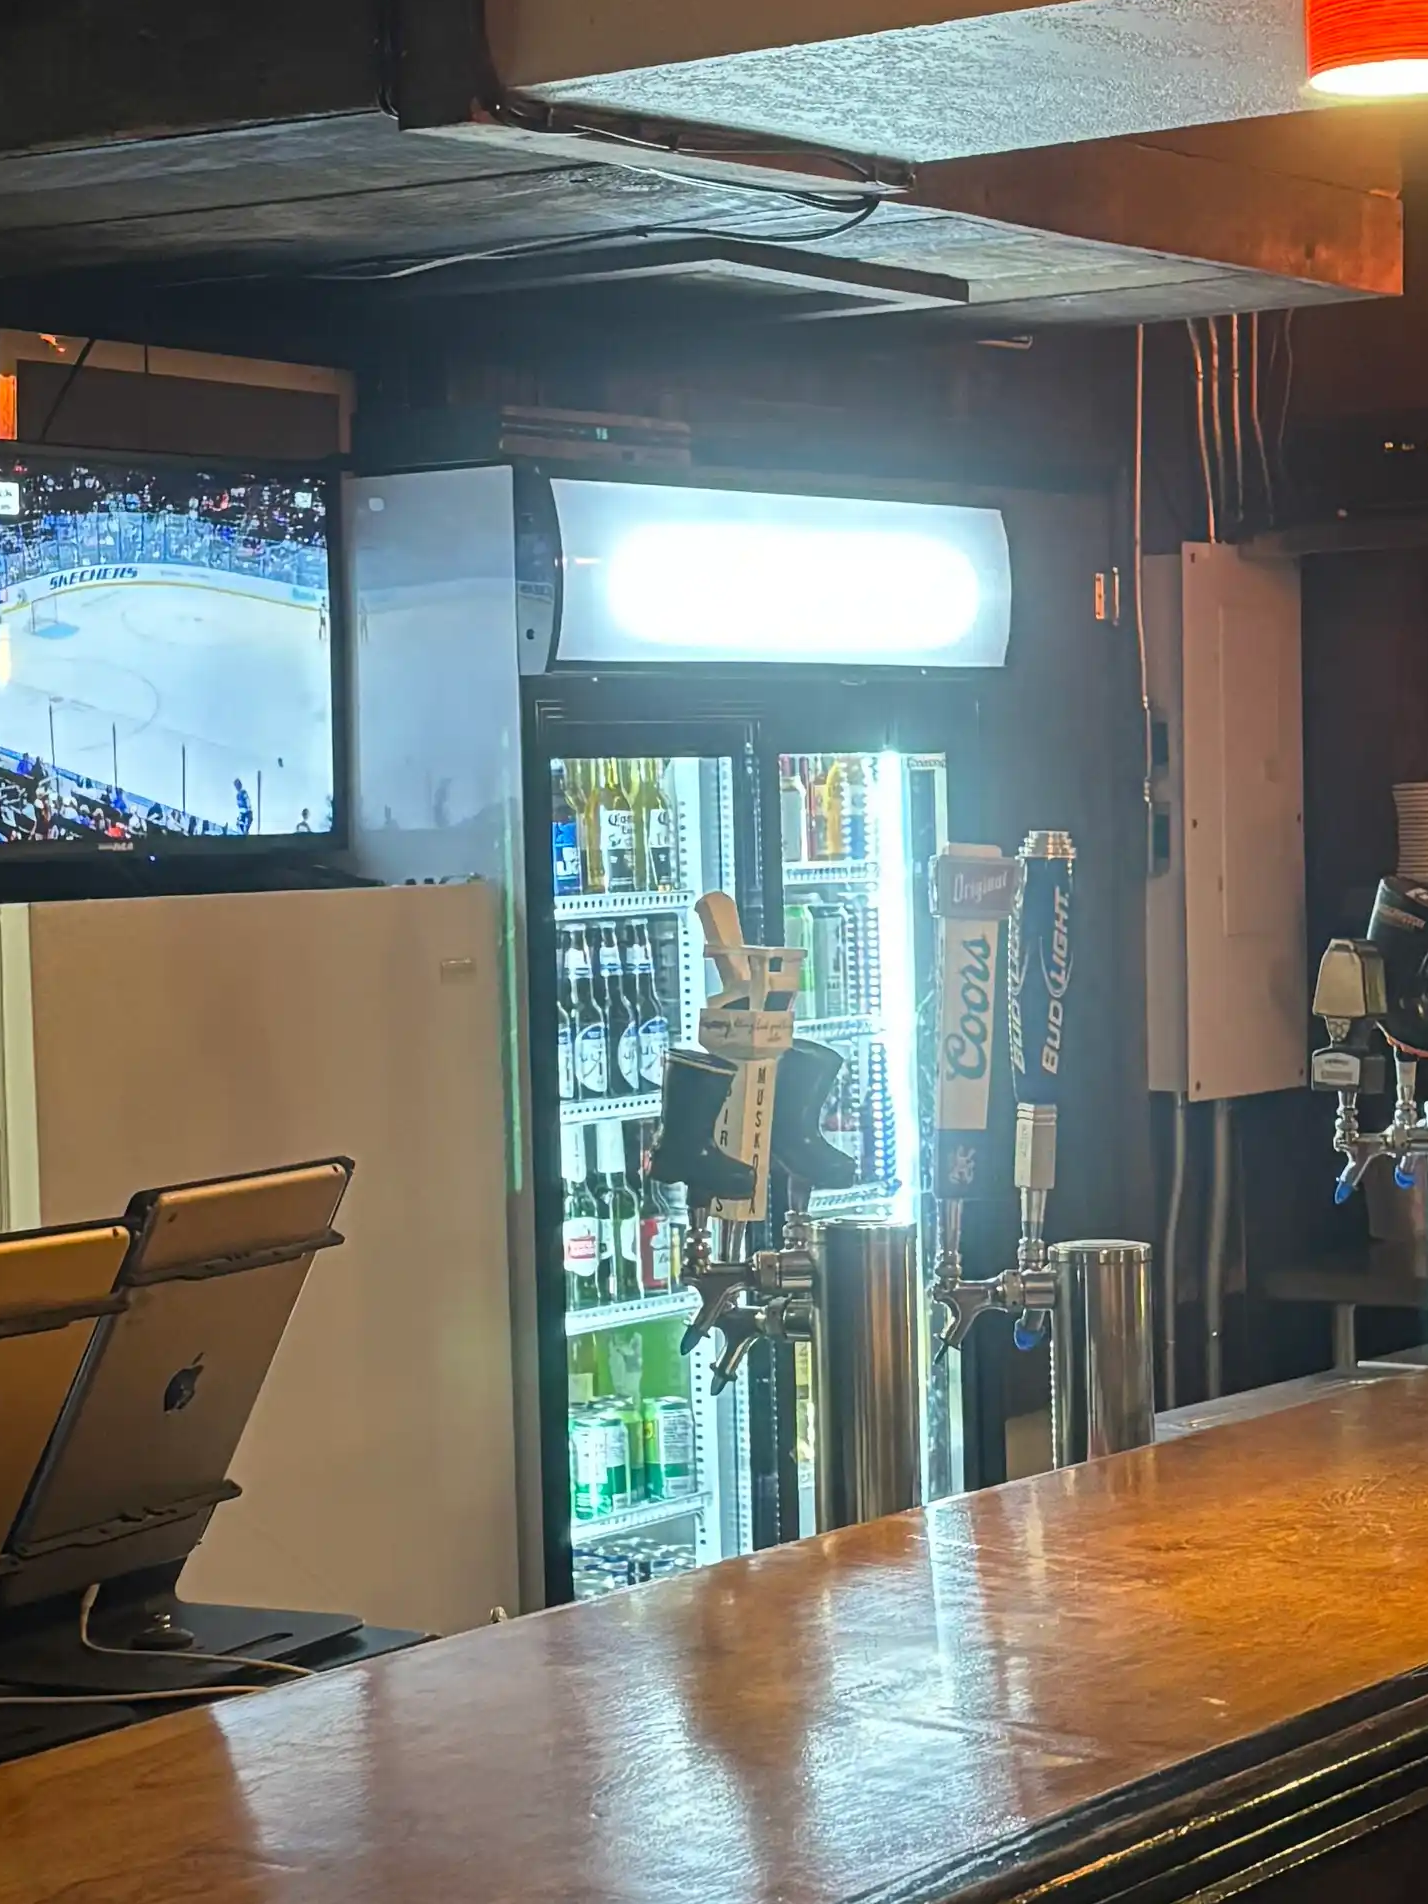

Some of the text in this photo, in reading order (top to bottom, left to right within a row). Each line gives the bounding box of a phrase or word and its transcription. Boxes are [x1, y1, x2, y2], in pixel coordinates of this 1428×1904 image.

[48, 566, 138, 591] SKECHERS
[952, 870, 1008, 904] Original
[943, 932, 992, 1082] Coors
[1041, 999, 1066, 1075] BUD
